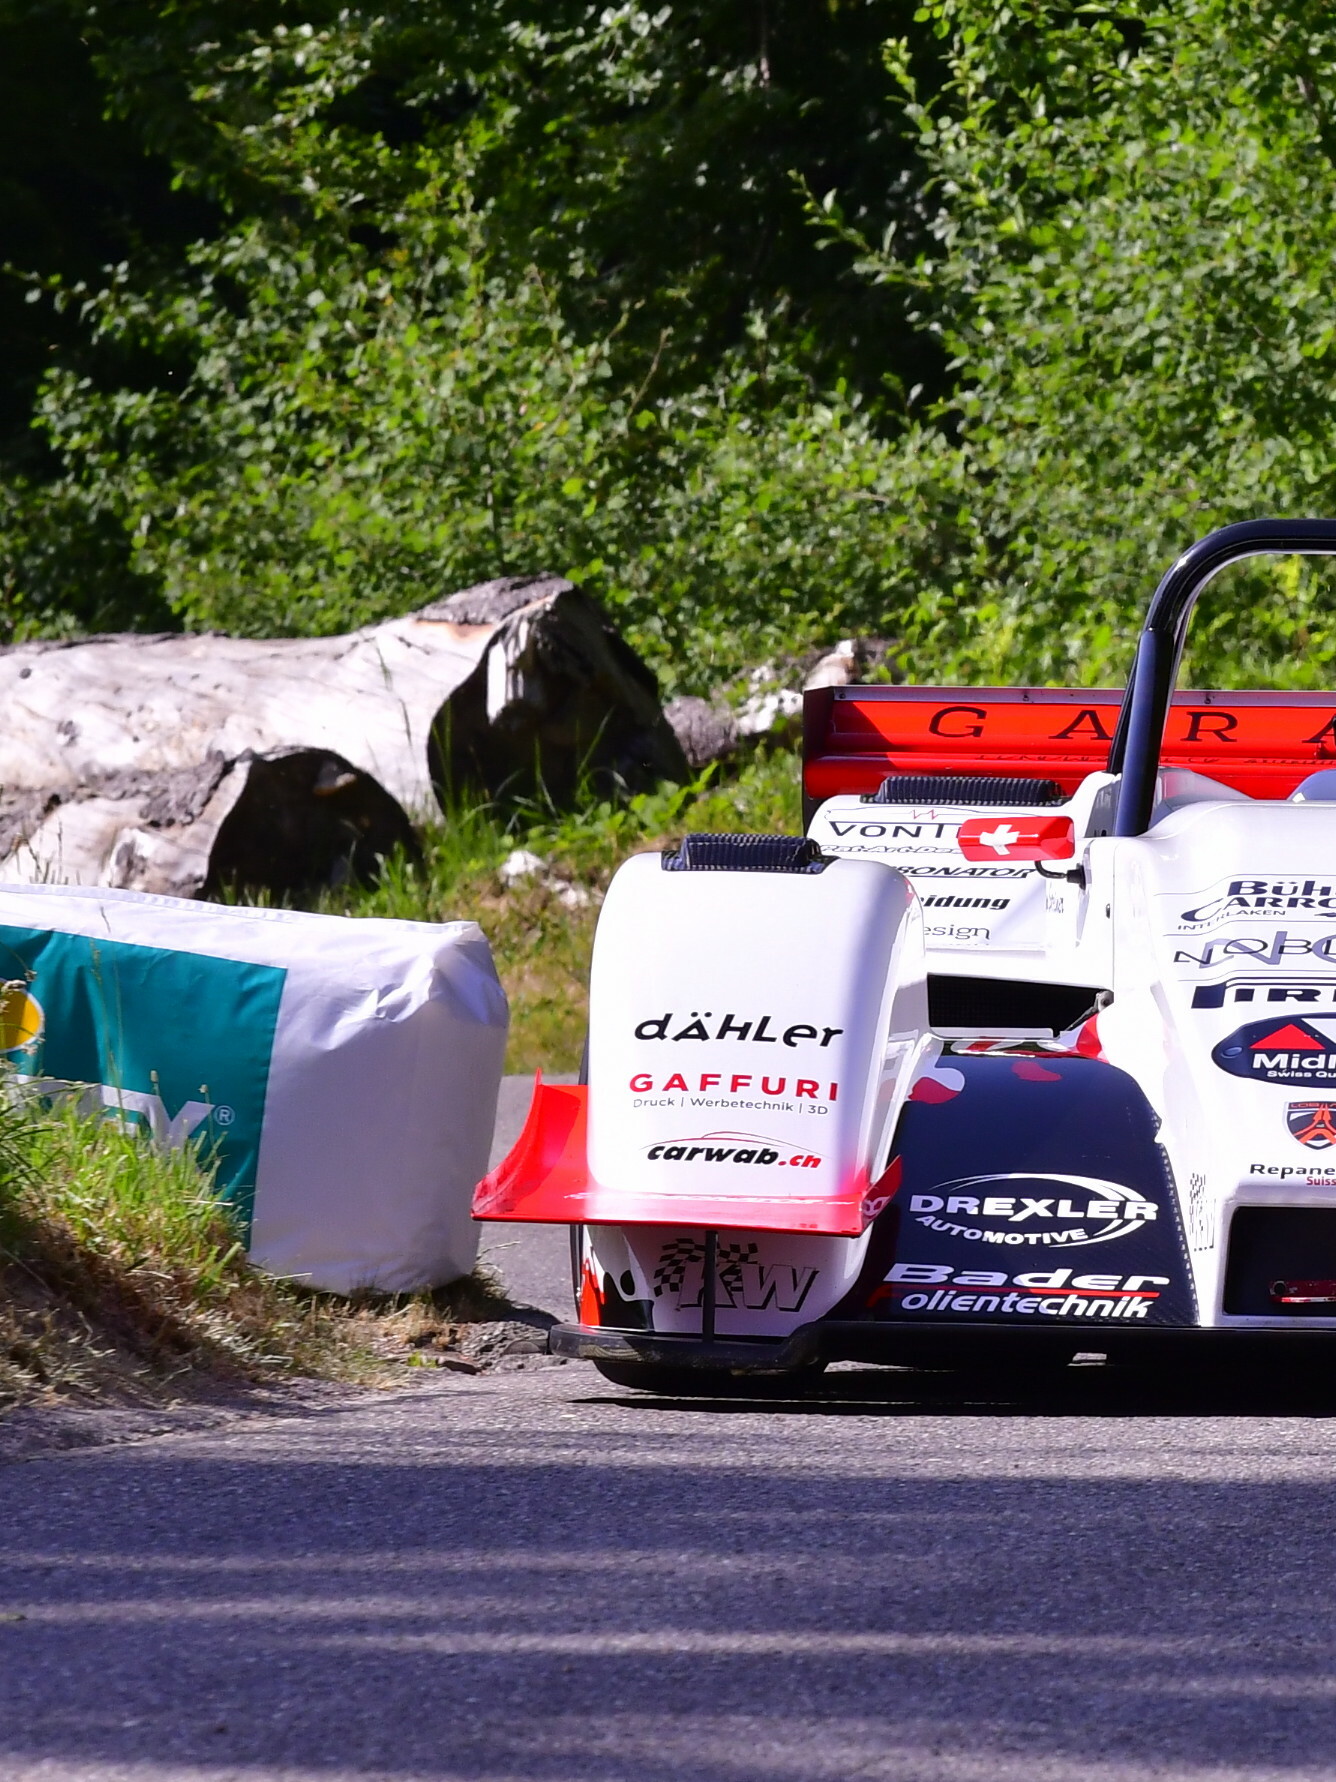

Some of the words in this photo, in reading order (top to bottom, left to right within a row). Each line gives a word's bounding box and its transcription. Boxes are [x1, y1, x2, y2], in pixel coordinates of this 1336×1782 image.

[920, 895, 1010, 910] idung
[1267, 1070, 1312, 1078] Swiss
[629, 1073, 838, 1102] GAFFURI
[633, 1097, 675, 1108] Druck
[690, 1097, 794, 1112] Werbetechnik
[808, 1105, 828, 1115] 3D
[647, 1144, 822, 1168] carwab.ch
[909, 1194, 1159, 1221] DREXLER
[915, 1215, 1089, 1245] AUTOMOTIVE
[883, 1263, 1170, 1291] Bader
